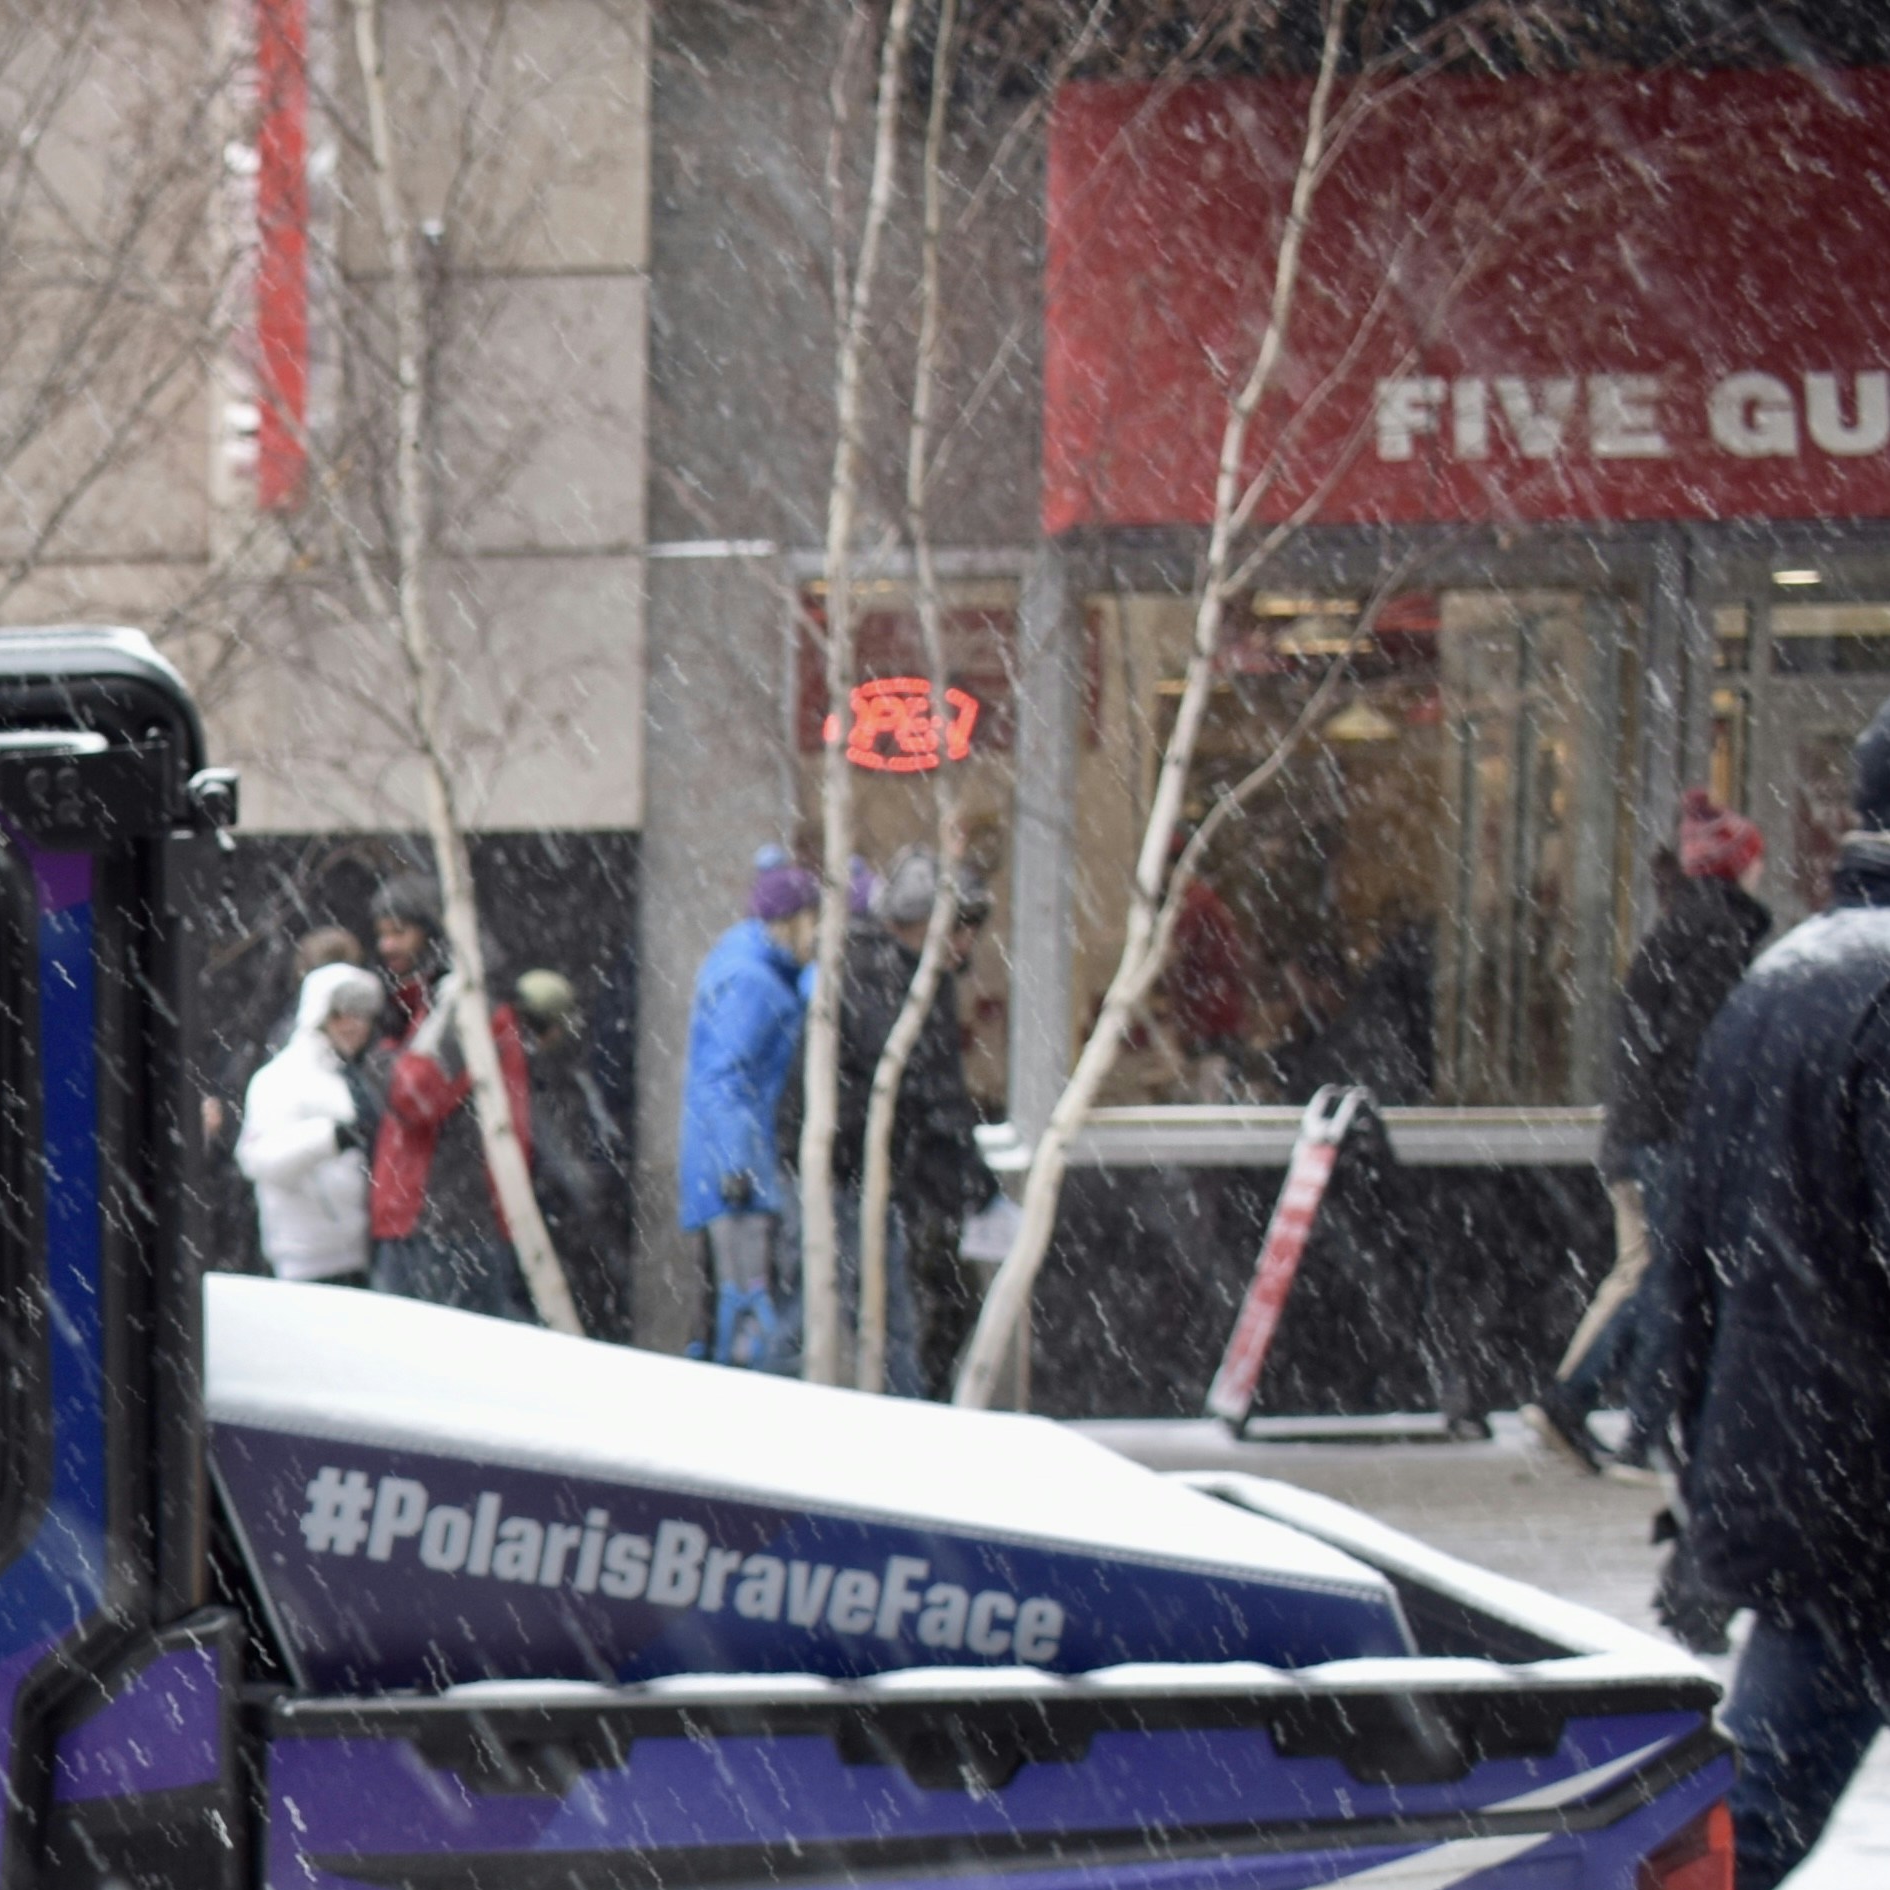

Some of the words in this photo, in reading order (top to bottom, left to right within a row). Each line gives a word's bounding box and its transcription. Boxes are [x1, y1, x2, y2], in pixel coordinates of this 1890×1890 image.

[1375, 373, 1668, 461] FIVE
[1708, 369, 1890, 456] GU
[300, 1465, 1067, 1664] #PolarisBraveFace
